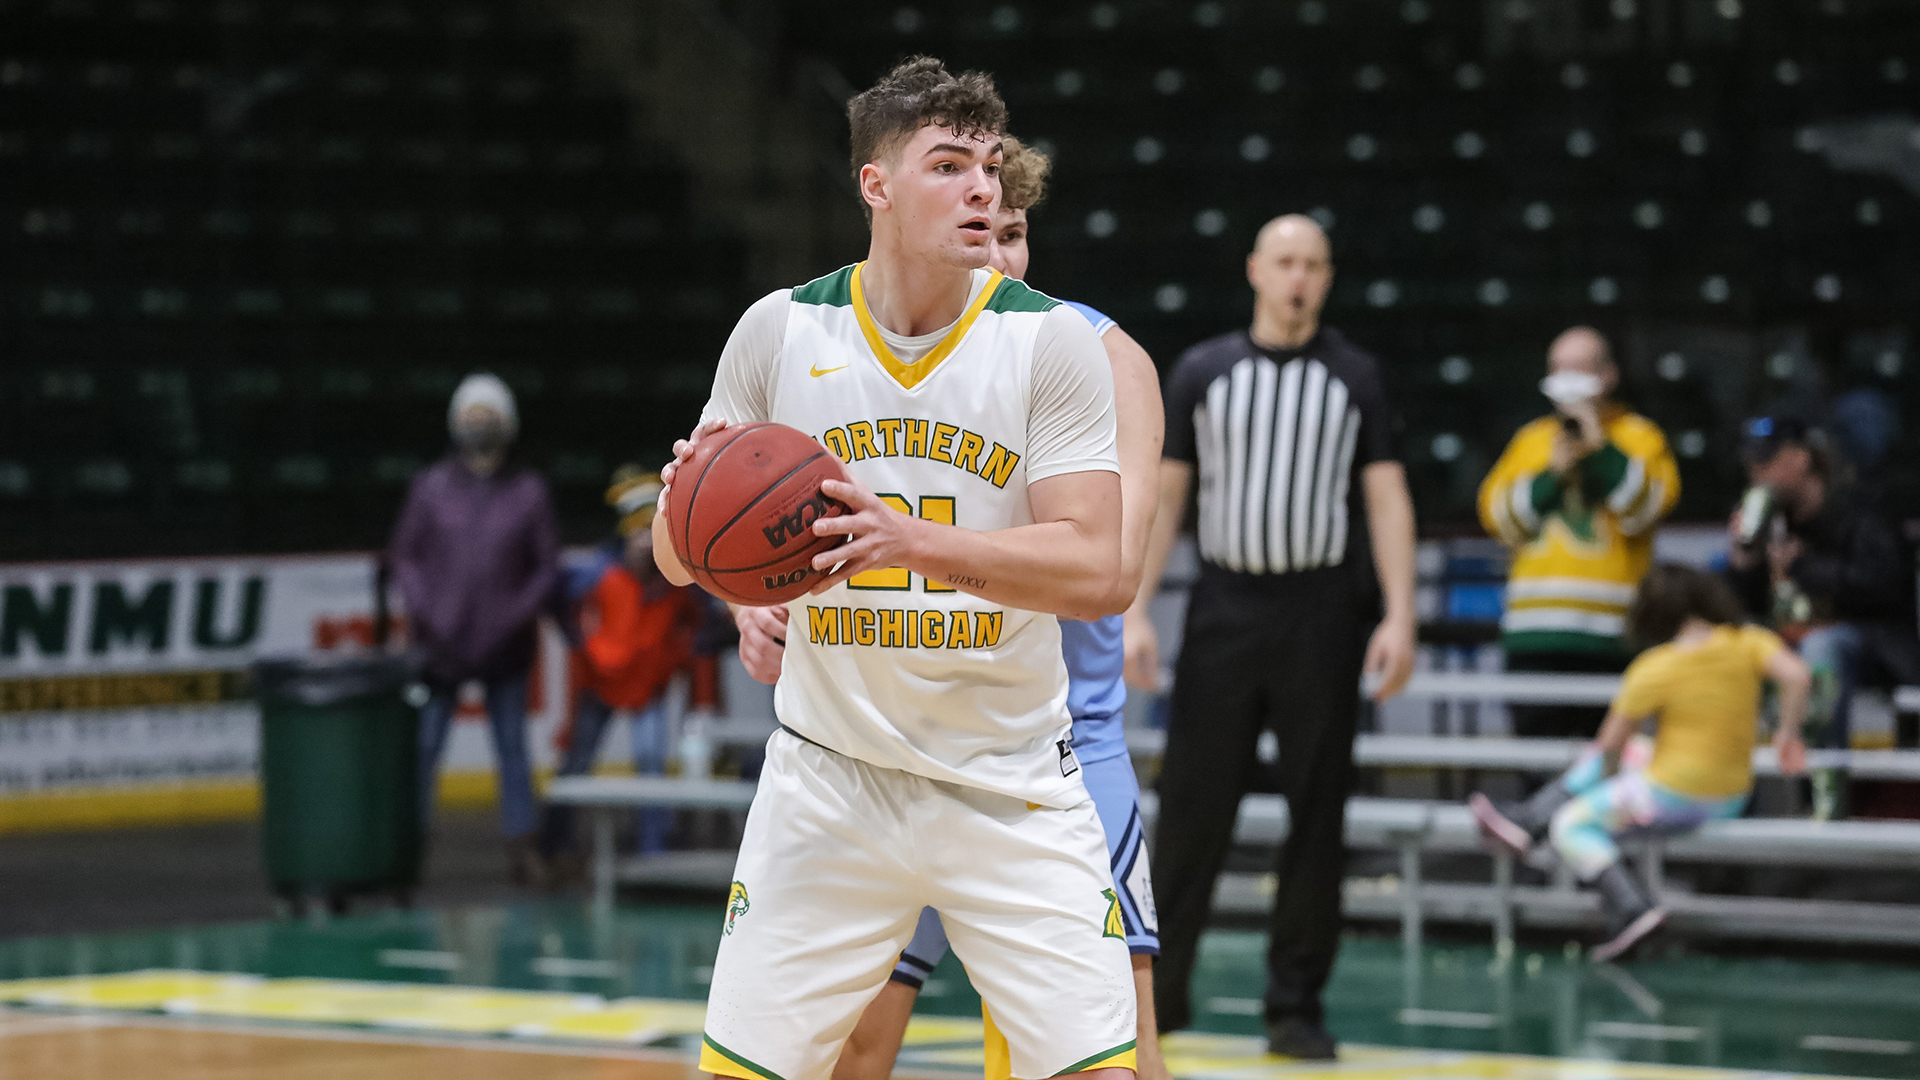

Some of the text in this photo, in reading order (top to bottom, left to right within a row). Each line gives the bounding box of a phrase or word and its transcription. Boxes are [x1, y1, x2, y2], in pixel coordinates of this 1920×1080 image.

[814, 418, 1021, 489] ORTHERN
[1, 577, 266, 656] NMU
[807, 606, 1003, 649] MICHIGAN
